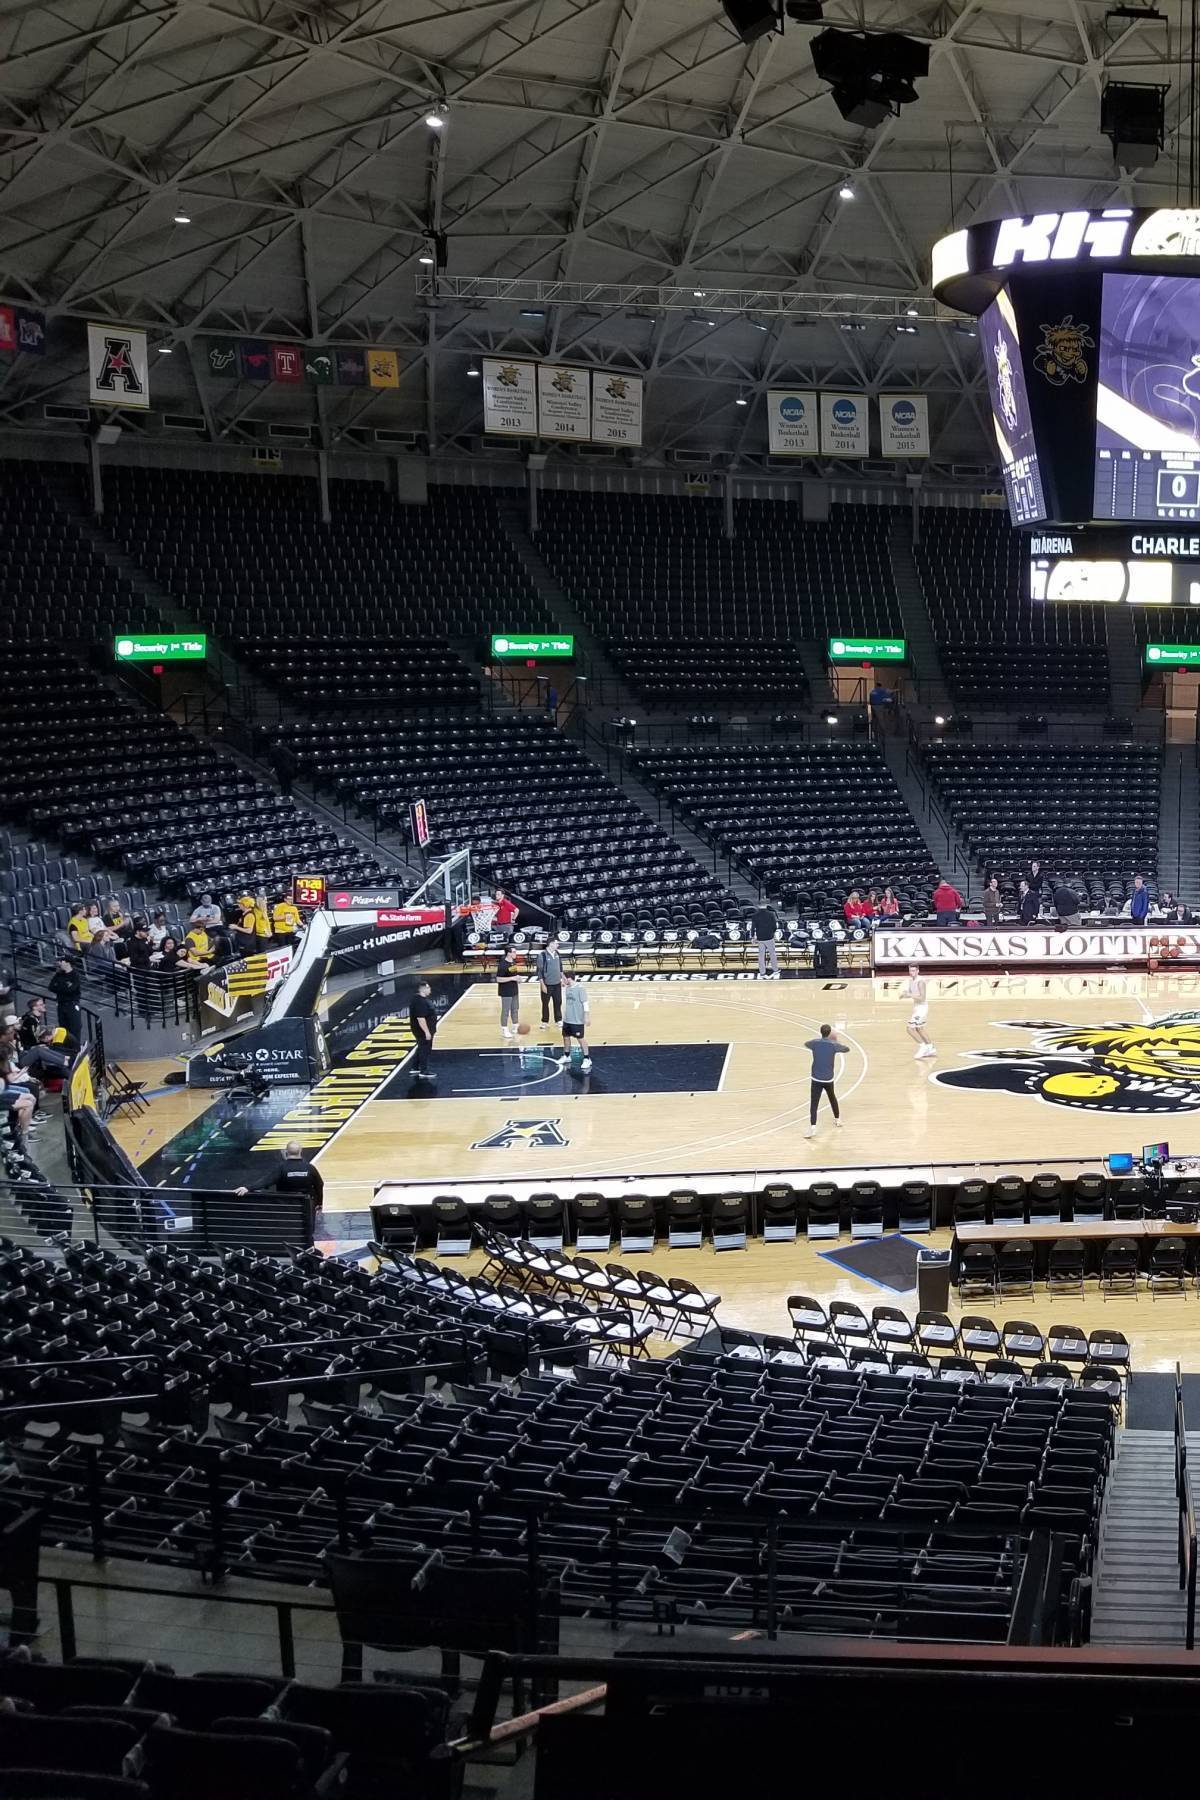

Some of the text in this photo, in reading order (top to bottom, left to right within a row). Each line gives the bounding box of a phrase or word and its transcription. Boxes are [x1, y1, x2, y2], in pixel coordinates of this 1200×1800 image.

[783, 408, 804, 417] NCAA
[835, 410, 857, 419] NCAA
[894, 411, 916, 420] NCAA
[500, 417, 521, 427] 2013
[555, 423, 575, 432] 2014
[607, 428, 627, 439] 2015
[783, 438, 804, 447] 2013
[835, 440, 855, 449] 2014
[896, 441, 915, 450] 2015
[1171, 475, 1186, 498] 0
[1041, 536, 1073, 554] ARENA
[182, 642, 202, 651] Title
[551, 642, 570, 650] Title
[885, 645, 902, 653] Title
[300, 889, 318, 901] 23
[375, 928, 411, 945] UNDER
[413, 924, 443, 936] ARMO
[880, 936, 1028, 958] KANSAS
[271, 1049, 303, 1060] STAR
